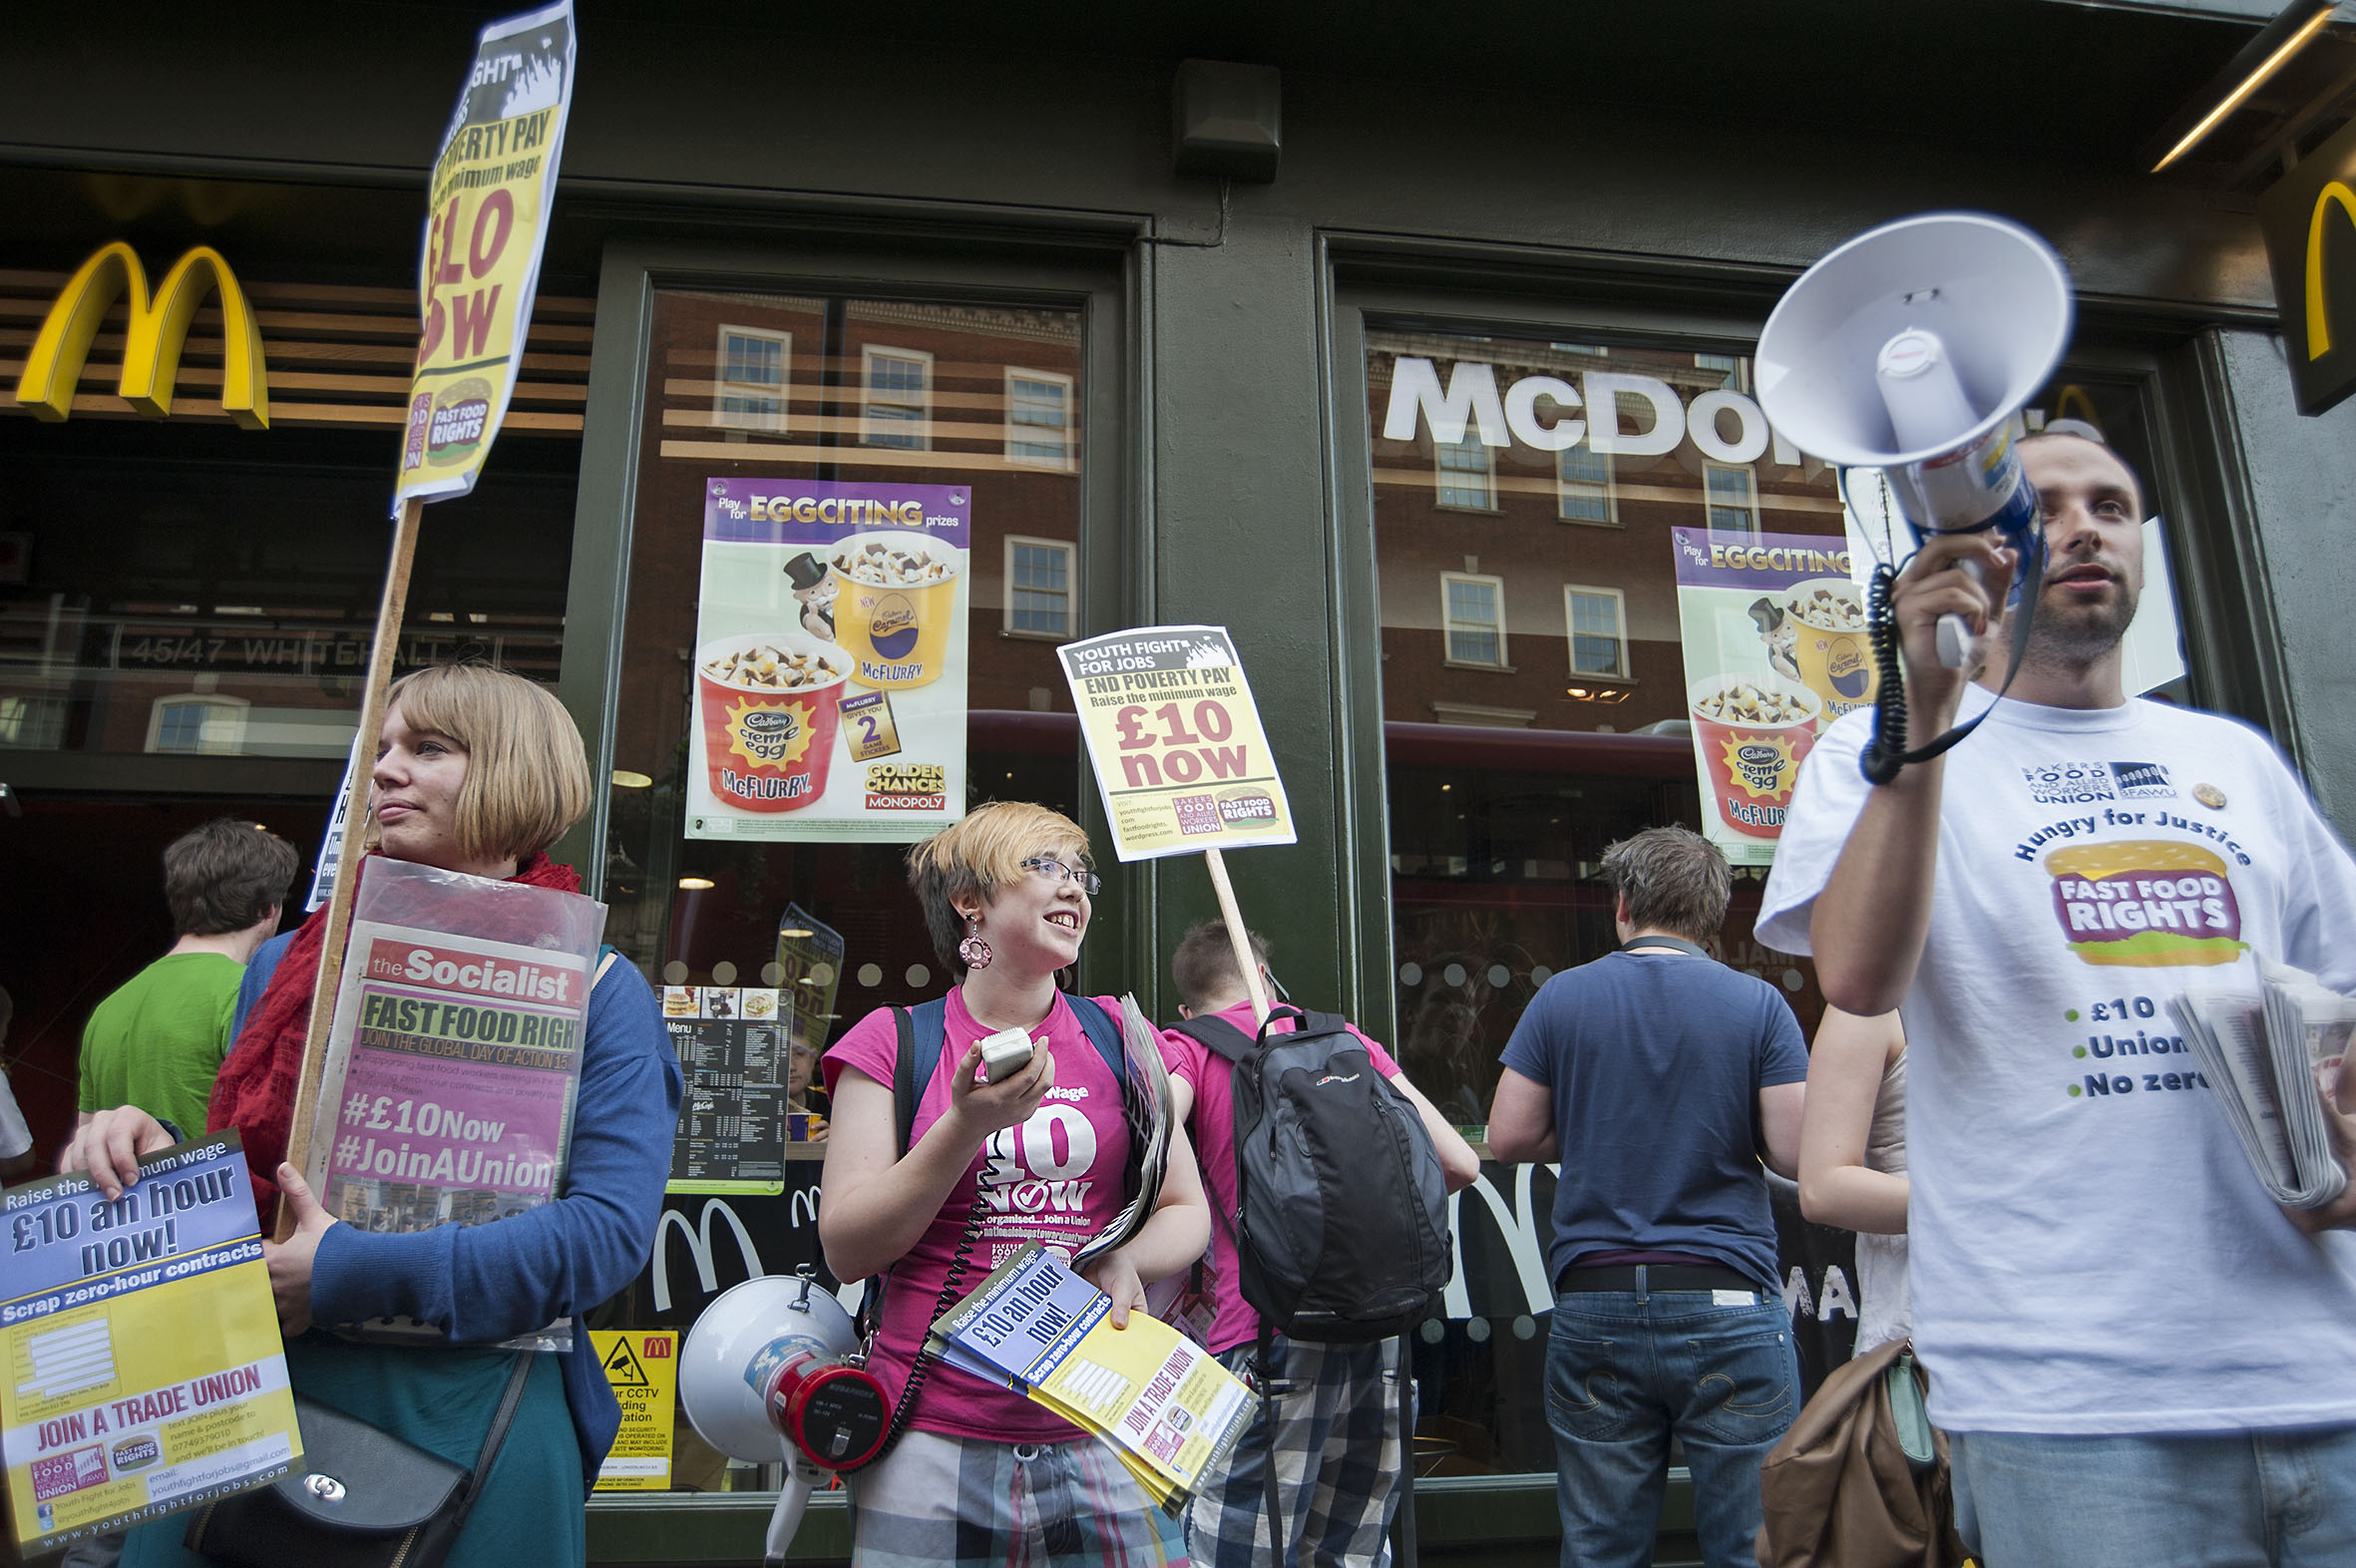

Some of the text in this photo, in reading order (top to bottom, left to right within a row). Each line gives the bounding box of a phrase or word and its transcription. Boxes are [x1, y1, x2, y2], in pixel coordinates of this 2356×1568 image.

[513, 111, 552, 153] PAY
[506, 155, 542, 182] wage
[419, 283, 503, 368] ow
[436, 403, 487, 424] FAST FOOD
[1383, 356, 1801, 466] McDo
[431, 417, 484, 444] RIGHTS
[718, 497, 740, 511] Play
[730, 509, 746, 520] for
[749, 495, 959, 528] EGGCITING prizes
[1683, 546, 1703, 558] Play
[1695, 556, 1709, 567] for
[1710, 544, 1851, 574] EGGCITING
[860, 595, 875, 608] NEW
[873, 609, 914, 632] Caramel
[131, 638, 225, 663] 45/47
[1073, 639, 1184, 662] YOUTH FIGHT
[1815, 639, 1828, 651] NEW
[1079, 655, 1156, 675] FOR JOBS
[1829, 651, 1863, 673] Caramel
[1085, 667, 1231, 694] END POVERTY PAY
[1089, 685, 1237, 707] Raise the minimum wage
[747, 713, 788, 727] Cadbury
[847, 705, 882, 719] GIVES YOU
[739, 725, 800, 744] creme
[858, 715, 881, 744] 2
[1115, 700, 1233, 750] £10
[745, 741, 787, 760] egg
[860, 744, 891, 757] STICKERS
[864, 741, 883, 750] GAME
[1741, 748, 1774, 760] Cadbury
[868, 763, 945, 779] GOLDEN
[1119, 745, 1247, 788] now
[1736, 758, 1786, 776] creme
[2021, 762, 2104, 774] BAKERS
[2025, 769, 2105, 782] FOOD
[865, 777, 947, 793] CHANCES
[1743, 772, 1777, 790] egg
[2029, 784, 2112, 796] WORKERS
[2066, 777, 2109, 786] ALLIED
[869, 797, 943, 808] MONOPOLY
[1174, 795, 1213, 805] BAKERS
[1176, 803, 1215, 814] FOOD
[1221, 798, 1270, 809] FAST FOOD
[2033, 792, 2116, 804] UNION
[1181, 816, 1219, 826] WORKERS
[1224, 805, 1273, 820] RIGHTS
[1124, 829, 1174, 842] wordpress.com
[1183, 823, 1222, 835] UNION
[2014, 808, 2251, 867] Hungry for Justice
[2059, 878, 2223, 900] FAST FOOD
[2067, 898, 2228, 932] RIGHTS
[374, 950, 570, 1001] the Socialist
[363, 993, 439, 1034] FAST
[439, 1004, 518, 1044] FOOD
[2090, 996, 2156, 1022] £10
[666, 1022, 692, 1034] Menu
[361, 1028, 569, 1070] JOIN THE GLOBAL DAY OF ACTION 15
[1045, 1086, 1089, 1101] Wage
[2084, 1074, 2134, 1098] No
[342, 1092, 506, 1143] #£10Now
[335, 1134, 555, 1190] #JoinAUnion
[6, 1186, 54, 1211] Raise
[57, 1176, 90, 1197] the
[181, 1142, 227, 1170] wage
[11, 1201, 81, 1255] £10
[90, 1192, 142, 1234] an
[148, 1165, 236, 1219] hour
[1043, 1215, 1063, 1225] Join
[1070, 1215, 1091, 1227] Union
[81, 1219, 179, 1277] now!
[3, 1241, 264, 1324] Scrap zero-hour contracts
[952, 1308, 978, 1331] Raise
[972, 1298, 989, 1314] the
[985, 1268, 1019, 1302] minimum
[1015, 1249, 1038, 1273] wage
[1015, 1262, 1065, 1307] hour
[1000, 1296, 1035, 1324] an
[971, 1312, 1015, 1349] £10
[1024, 1301, 1073, 1346] now!
[1027, 1296, 1112, 1383] Scrap zero-hour contracts
[1163, 1347, 1194, 1379] UNION
[626, 1388, 659, 1398] CCTV
[1143, 1371, 1176, 1407] TRADE
[38, 1414, 87, 1452] JOIN
[93, 1407, 111, 1435] A
[112, 1379, 191, 1429] TRADE
[198, 1363, 263, 1406] UNION
[168, 1401, 249, 1429] text JOIN plus your
[622, 1412, 652, 1422] ation
[1138, 1399, 1157, 1416] A
[170, 1414, 246, 1441] name postcode
[1124, 1405, 1151, 1436] JOIN
[116, 1442, 155, 1457] FAST FOOD
[116, 1448, 156, 1465] RIGHTS
[175, 1429, 265, 1463] and touch!
[32, 1456, 74, 1471] BAKERS
[33, 1461, 74, 1479] FOOD
[152, 1445, 291, 1497] youthfightforjobs@gmail.com
[150, 1467, 180, 1484] email:
[37, 1482, 77, 1500] UNION
[55, 1481, 137, 1510] Youth Fight Jobs
[44, 1464, 289, 1548] www.youthfightforjobs.com
